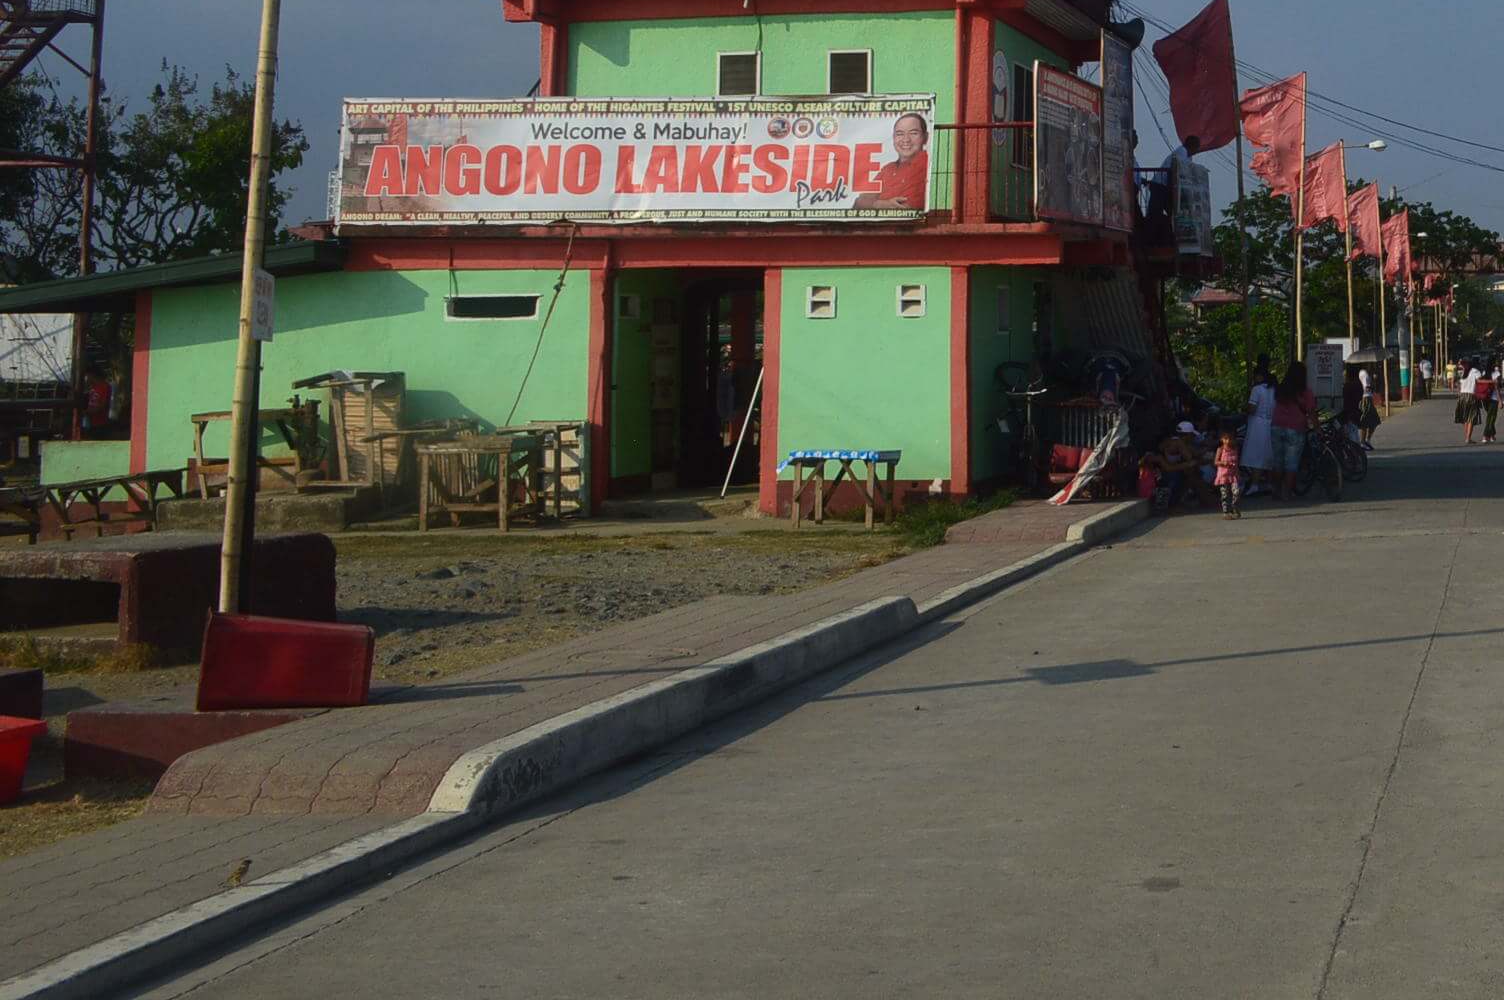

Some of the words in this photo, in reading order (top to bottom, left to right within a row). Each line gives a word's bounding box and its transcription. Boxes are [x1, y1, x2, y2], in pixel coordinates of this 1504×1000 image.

[348, 103, 368, 113] ART
[371, 103, 414, 113] CAPITAL
[417, 103, 433, 113] OF
[434, 103, 454, 113] THE
[456, 103, 524, 113] PHILIPPINES
[534, 103, 567, 113] HOME
[569, 103, 585, 113] OF
[587, 102, 609, 112] THE
[610, 102, 665, 112] HIGANTES
[667, 102, 716, 112] FESTIVAL
[727, 103, 745, 112] 1ST
[750, 103, 793, 112] UNESCO
[796, 102, 833, 112] ASEAN
[834, 101, 882, 111] CULTURE
[885, 101, 930, 110] CAPITAL
[531, 122, 626, 140] Welcome
[633, 122, 647, 140] &
[653, 121, 748, 143] Mabuhay!
[365, 143, 601, 196] ANGONO
[616, 143, 883, 194] LAKESIDE
[796, 177, 848, 208] Park
[341, 213, 374, 221] ANGONO
[417, 213, 442, 221] CLEAN,
[443, 213, 477, 221] HEALTHY,
[514, 212, 530, 220] AND
[687, 210, 703, 218] AND
[705, 210, 737, 218] HUMANE
[738, 210, 768, 218] SOCIETY
[769, 210, 789, 218] WITH
[790, 210, 804, 218] THE
[806, 210, 846, 218] BLESSINGS
[847, 210, 857, 218] OF
[858, 210, 876, 218] GOD
